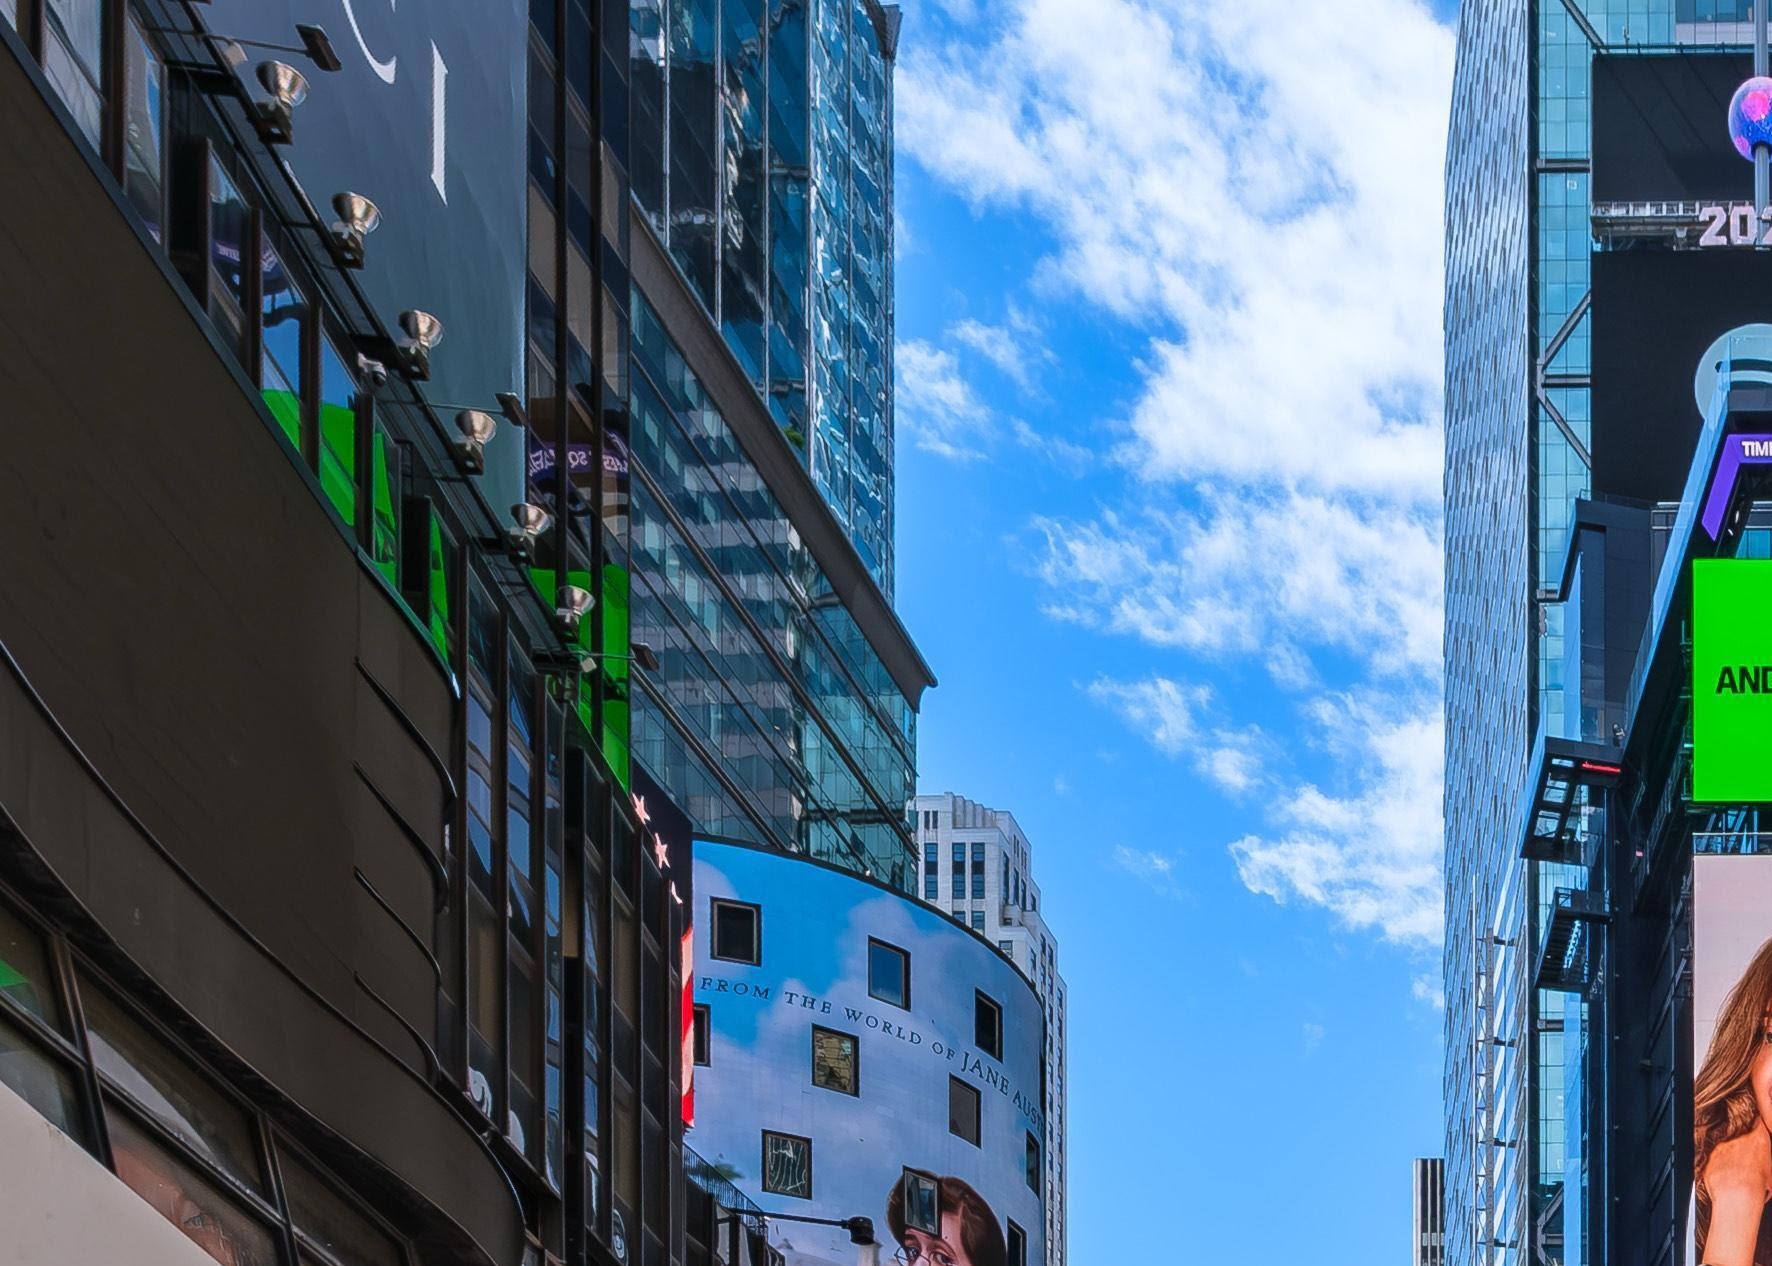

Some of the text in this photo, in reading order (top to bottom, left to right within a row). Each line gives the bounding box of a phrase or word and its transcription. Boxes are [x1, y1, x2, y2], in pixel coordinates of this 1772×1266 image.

[699, 976, 770, 1000] FROM
[784, 991, 832, 1015] THE
[844, 1007, 922, 1045] WORLD
[932, 1041, 955, 1060] OF
[961, 1051, 1010, 1096] JANE
